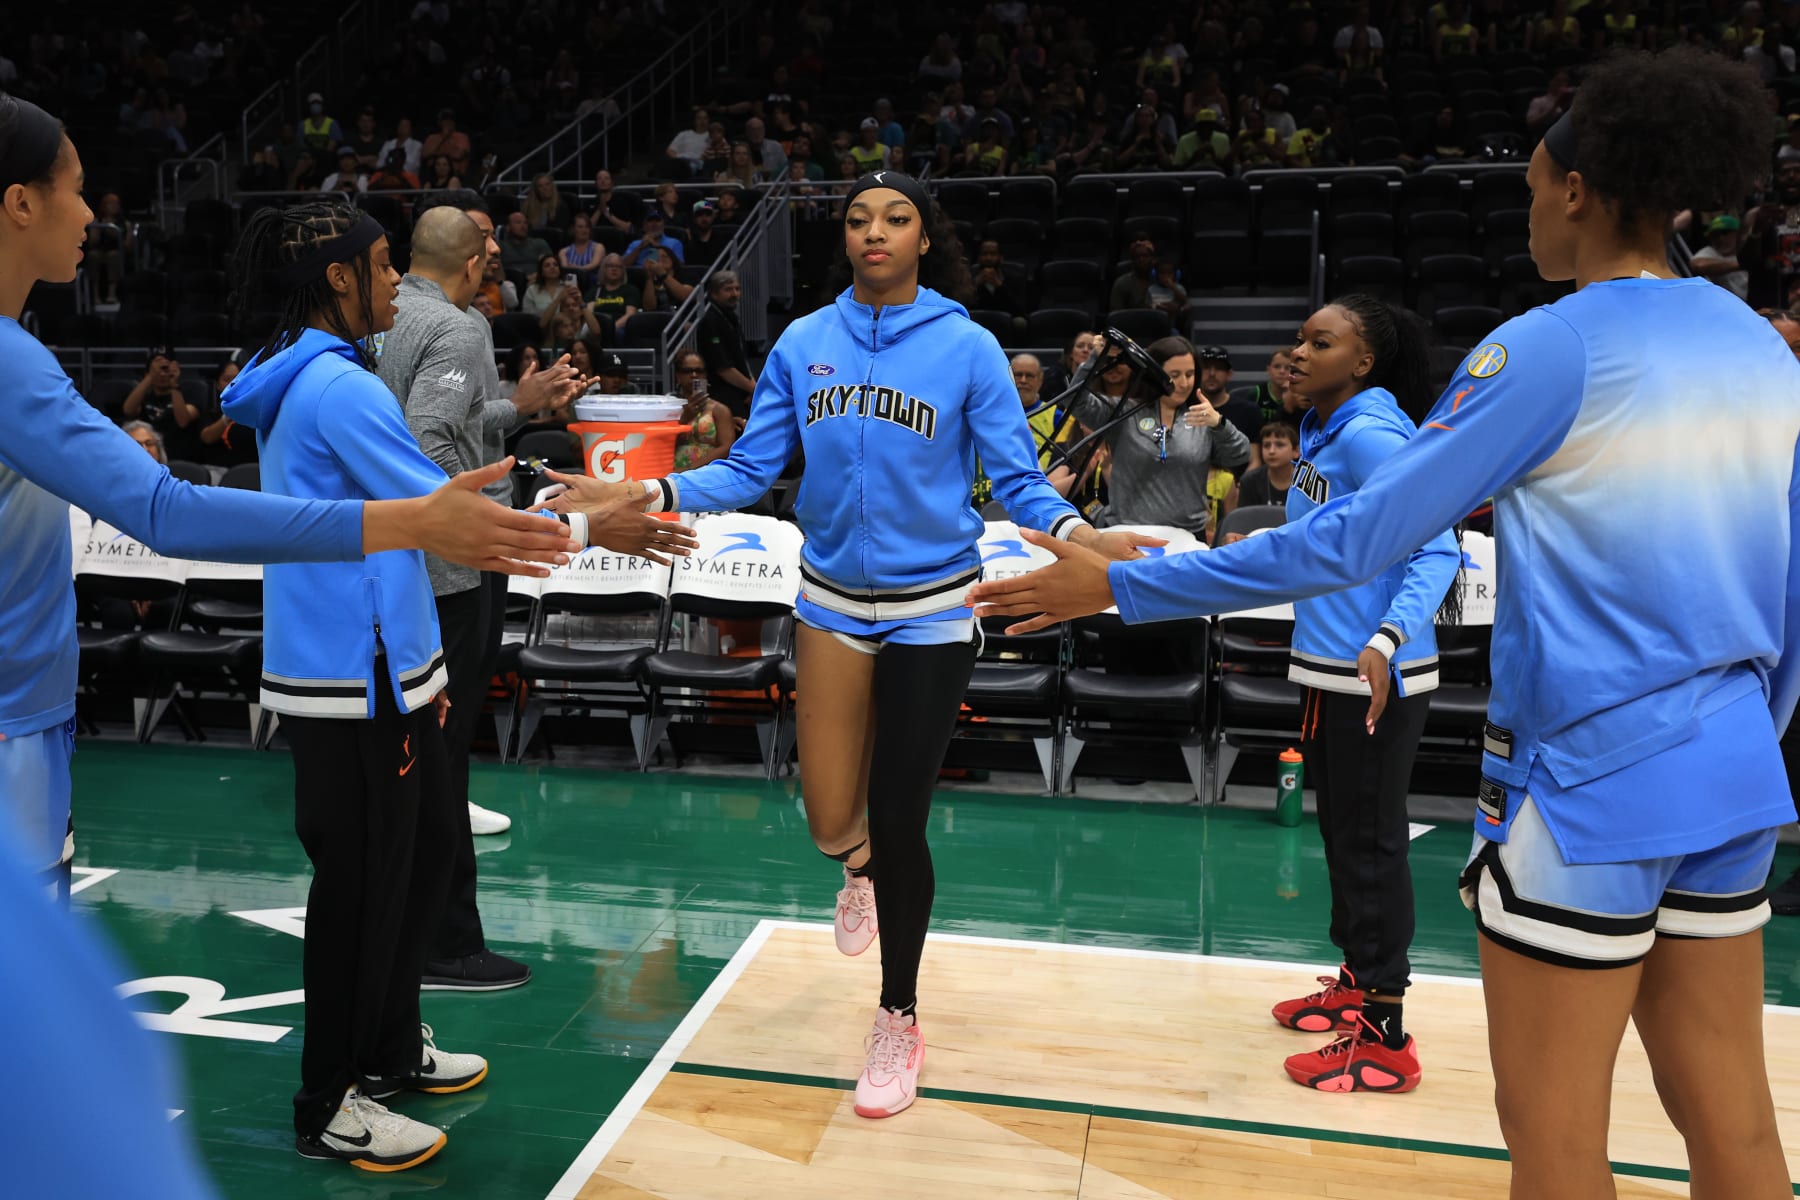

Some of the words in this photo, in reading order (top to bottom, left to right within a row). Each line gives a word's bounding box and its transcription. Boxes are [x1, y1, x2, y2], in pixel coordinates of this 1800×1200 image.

[810, 365, 831, 375] Ford
[592, 440, 625, 483] G
[85, 541, 160, 557] SYMET
[682, 557, 783, 578] SYMETRA
[1281, 773, 1296, 790] G
